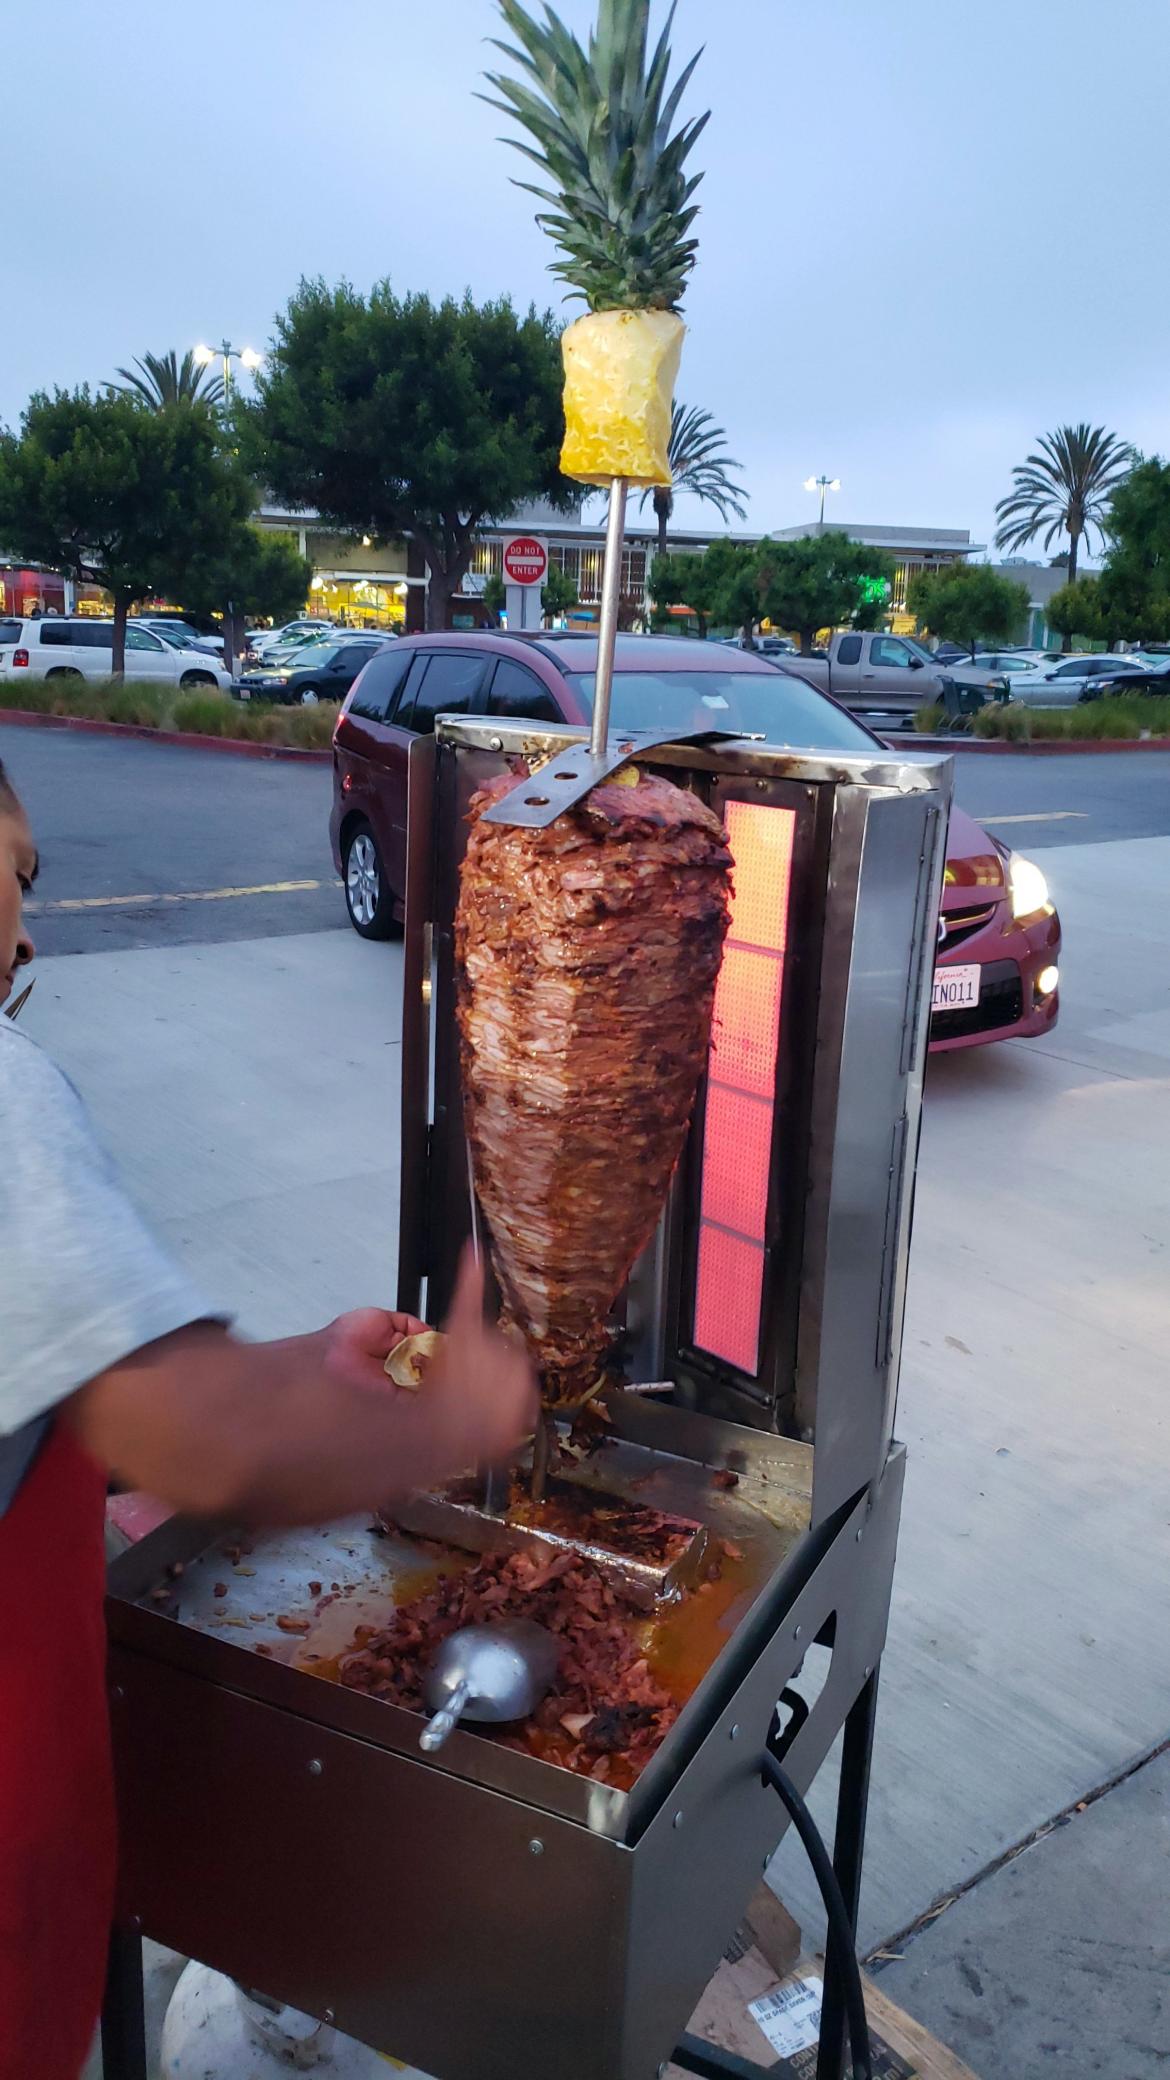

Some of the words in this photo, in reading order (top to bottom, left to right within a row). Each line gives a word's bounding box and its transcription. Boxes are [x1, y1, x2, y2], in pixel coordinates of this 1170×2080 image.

[510, 546, 521, 555] DO
[524, 547, 540, 555] NOT
[512, 566, 538, 575] ENTER
[932, 982, 973, 1004] IN011
